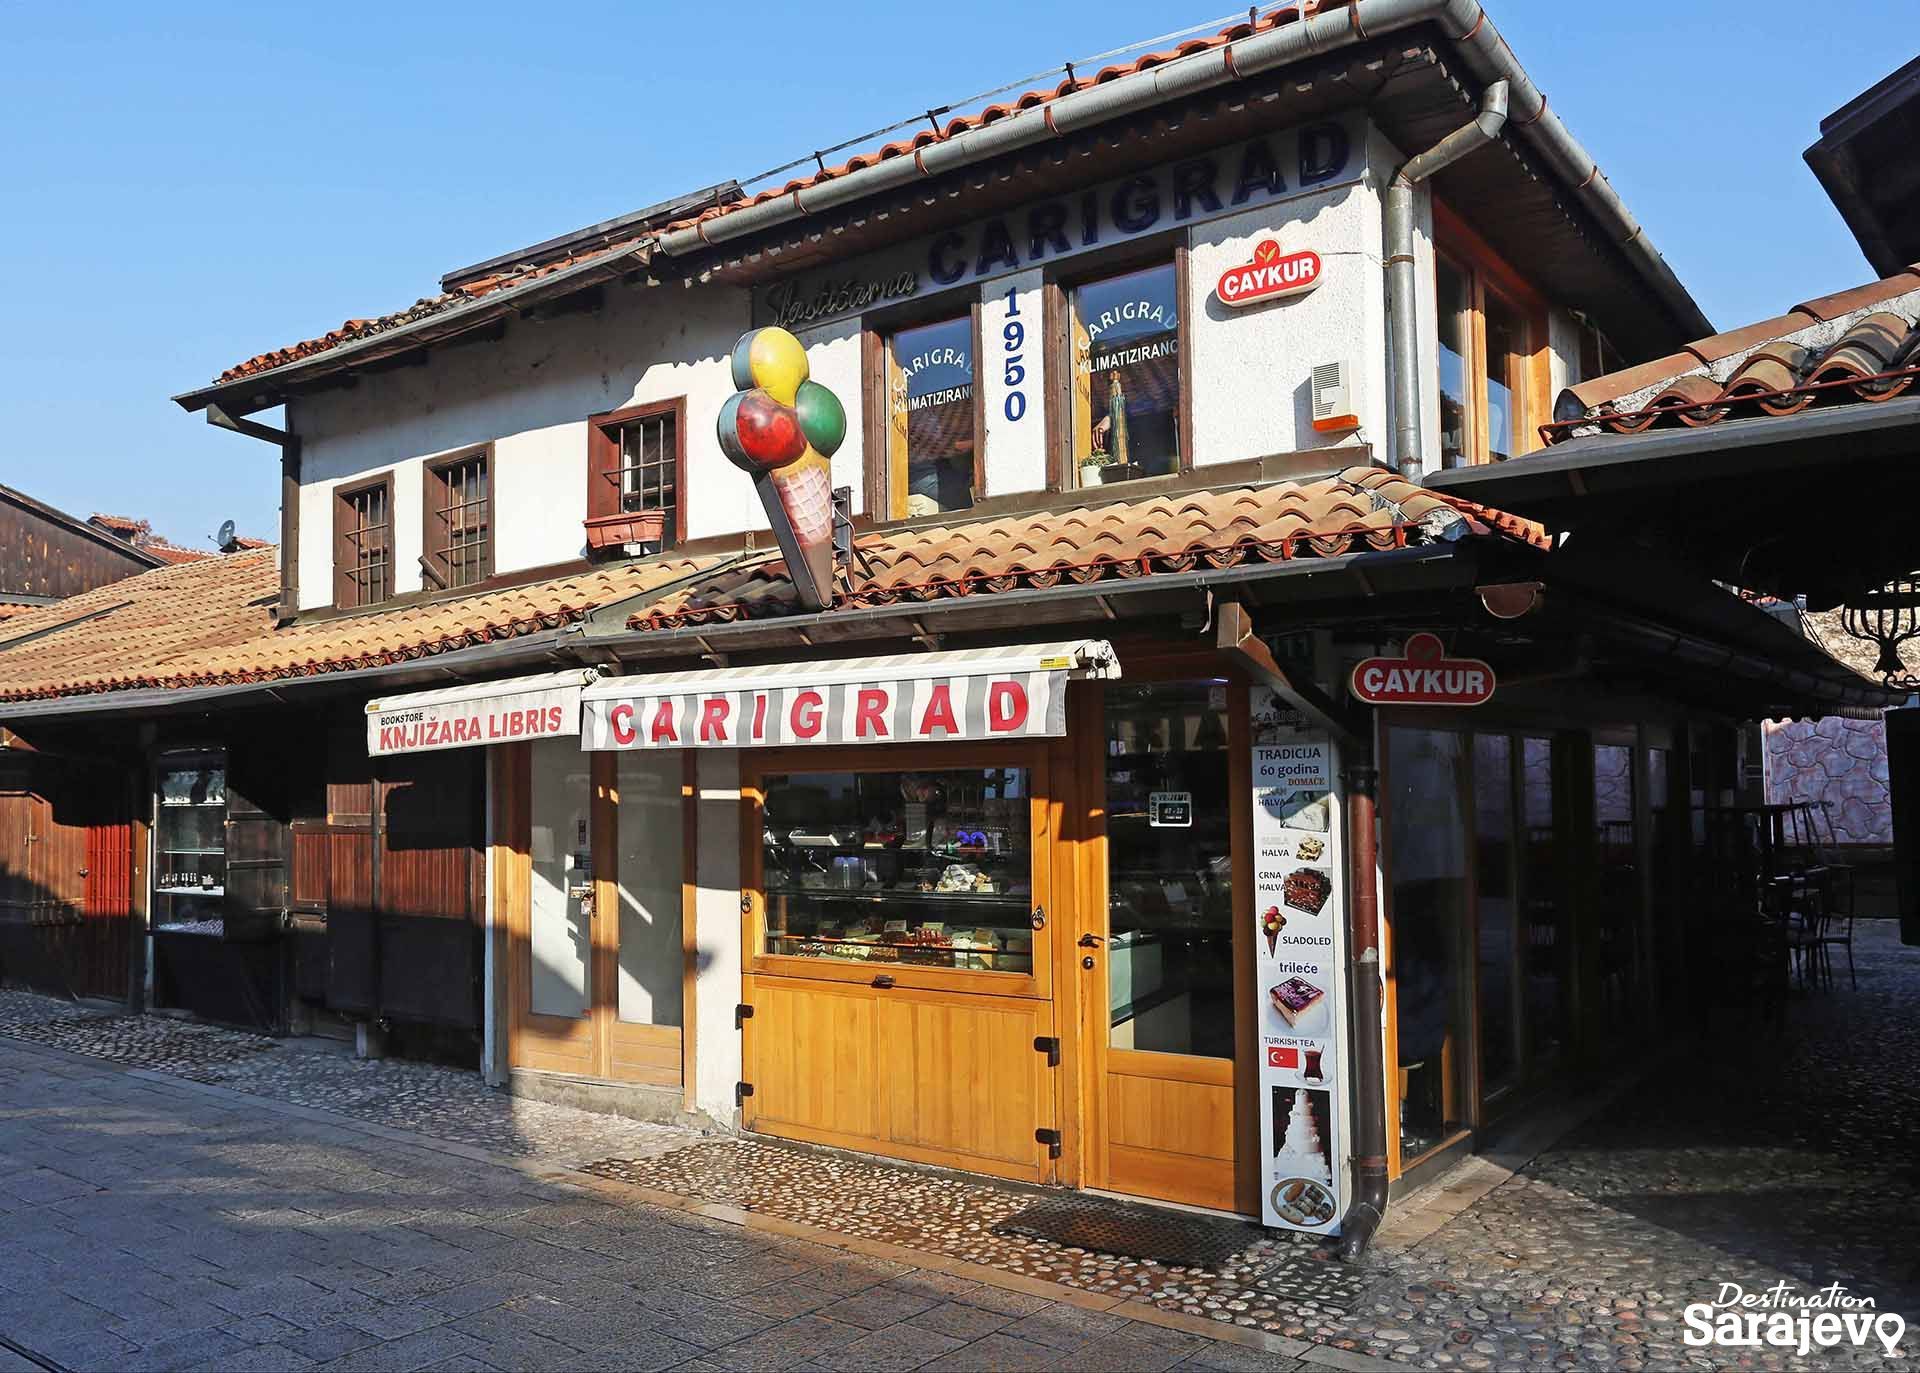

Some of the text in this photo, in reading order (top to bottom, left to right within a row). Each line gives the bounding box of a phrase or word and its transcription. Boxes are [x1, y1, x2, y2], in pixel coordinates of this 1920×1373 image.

[926, 120, 1351, 286] CARIGRAD
[1223, 257, 1315, 301] ÇAYKUR
[1003, 288, 1027, 423] 1950
[380, 712, 424, 726] BOOKSTORE
[610, 680, 1029, 746] CARIGRAD
[379, 706, 563, 751] KNJIŽARA LIBRIS
[1258, 747, 1321, 761] TRADICIJA
[1260, 764, 1320, 778] 60 godina
[1261, 848, 1290, 857] HALVA
[1258, 871, 1282, 880] CRNA
[1258, 883, 1286, 892] HALVA
[1282, 935, 1331, 946] SLADOLED
[1264, 1036, 1316, 1048] TURKISH TEA
